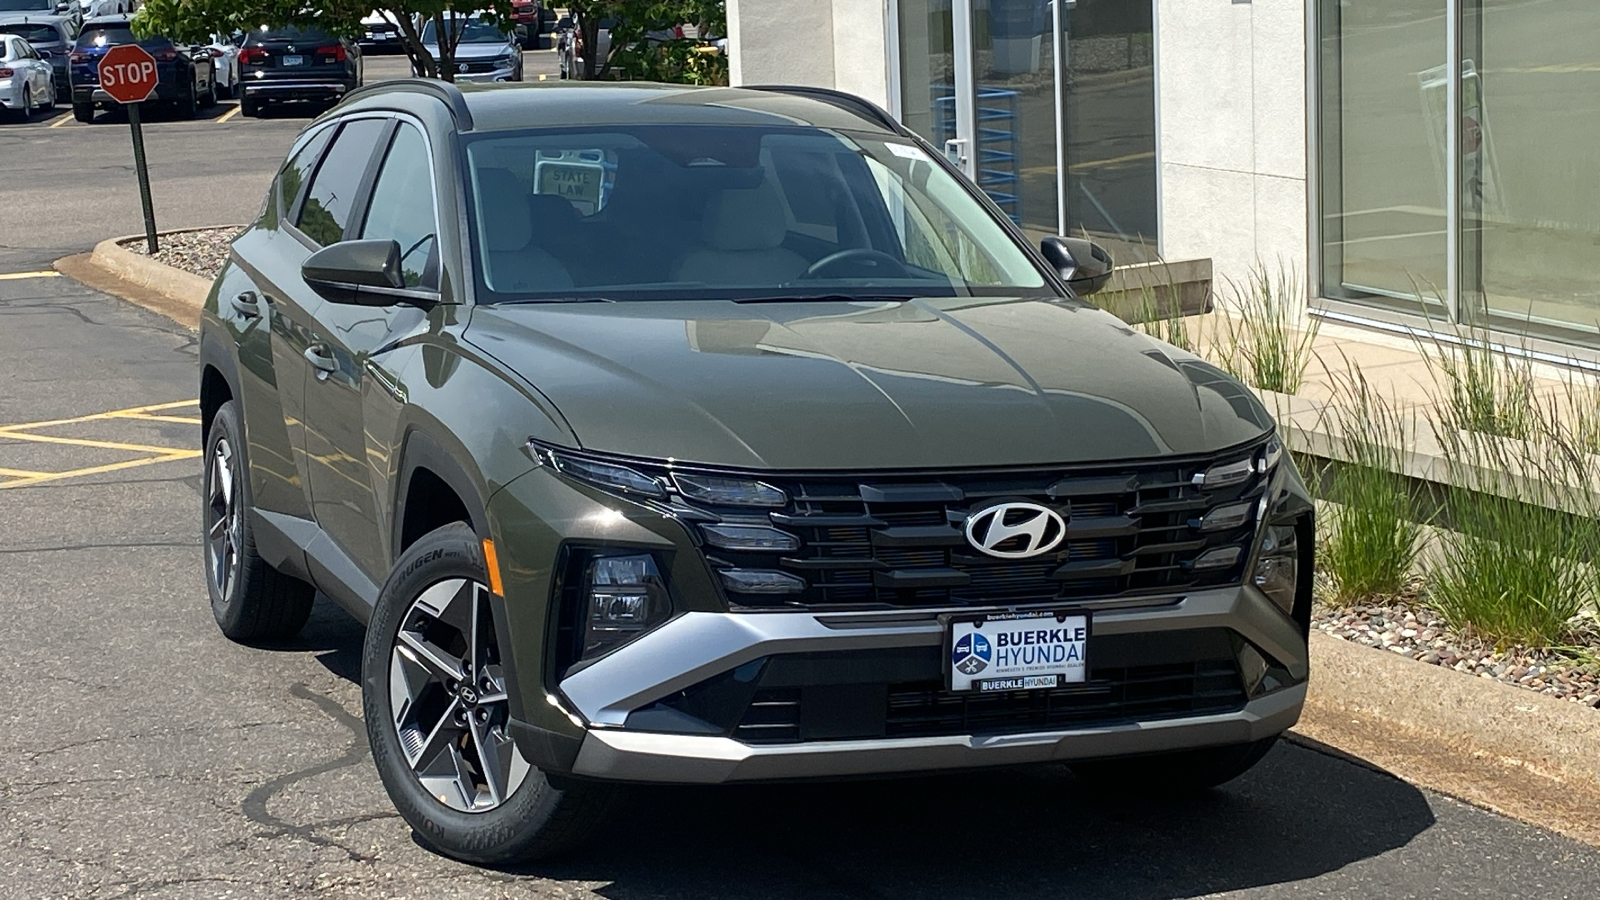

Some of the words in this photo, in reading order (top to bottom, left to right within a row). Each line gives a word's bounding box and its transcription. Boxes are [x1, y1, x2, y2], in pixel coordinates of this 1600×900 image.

[103, 61, 154, 87] STOP
[553, 169, 590, 184] STATE
[558, 183, 584, 196] LAW
[996, 627, 1085, 647] BUERKLE
[996, 643, 1085, 667] HYUNDAI
[982, 679, 1024, 691] BUERKLE
[1024, 677, 1056, 688] HYUNDAI
